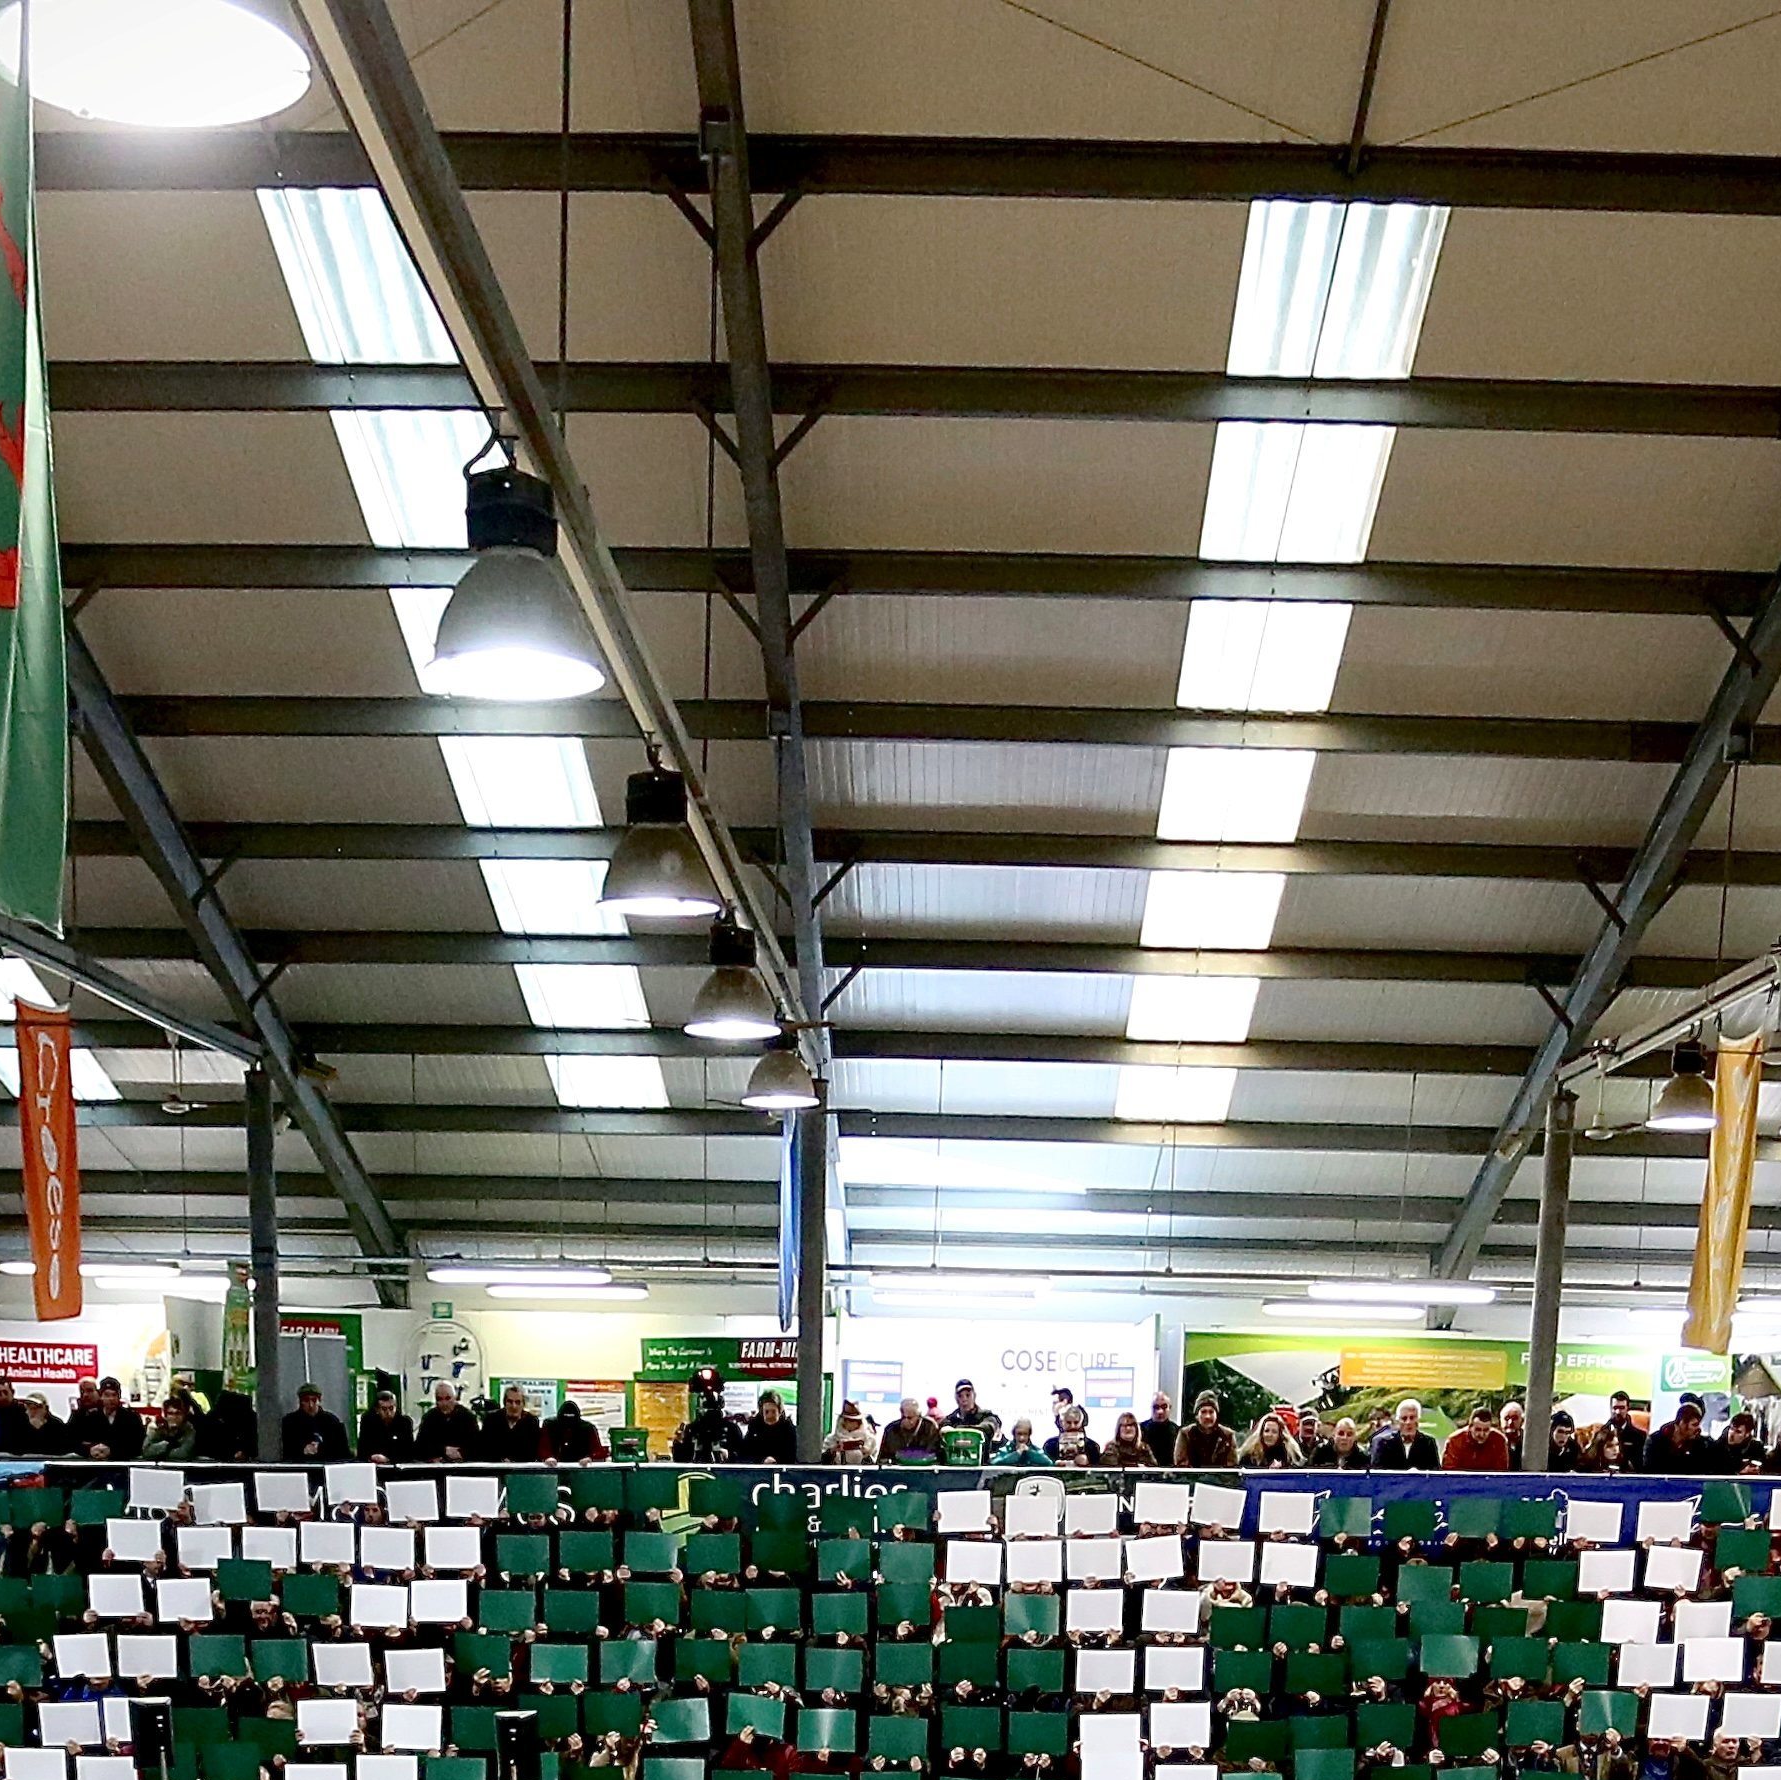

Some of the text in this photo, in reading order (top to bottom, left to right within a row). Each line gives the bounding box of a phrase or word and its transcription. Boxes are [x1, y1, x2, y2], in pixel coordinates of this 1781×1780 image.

[37, 1032, 63, 1302] Croeso
[7, 1367, 41, 1378] Animal
[43, 1367, 76, 1379] Health
